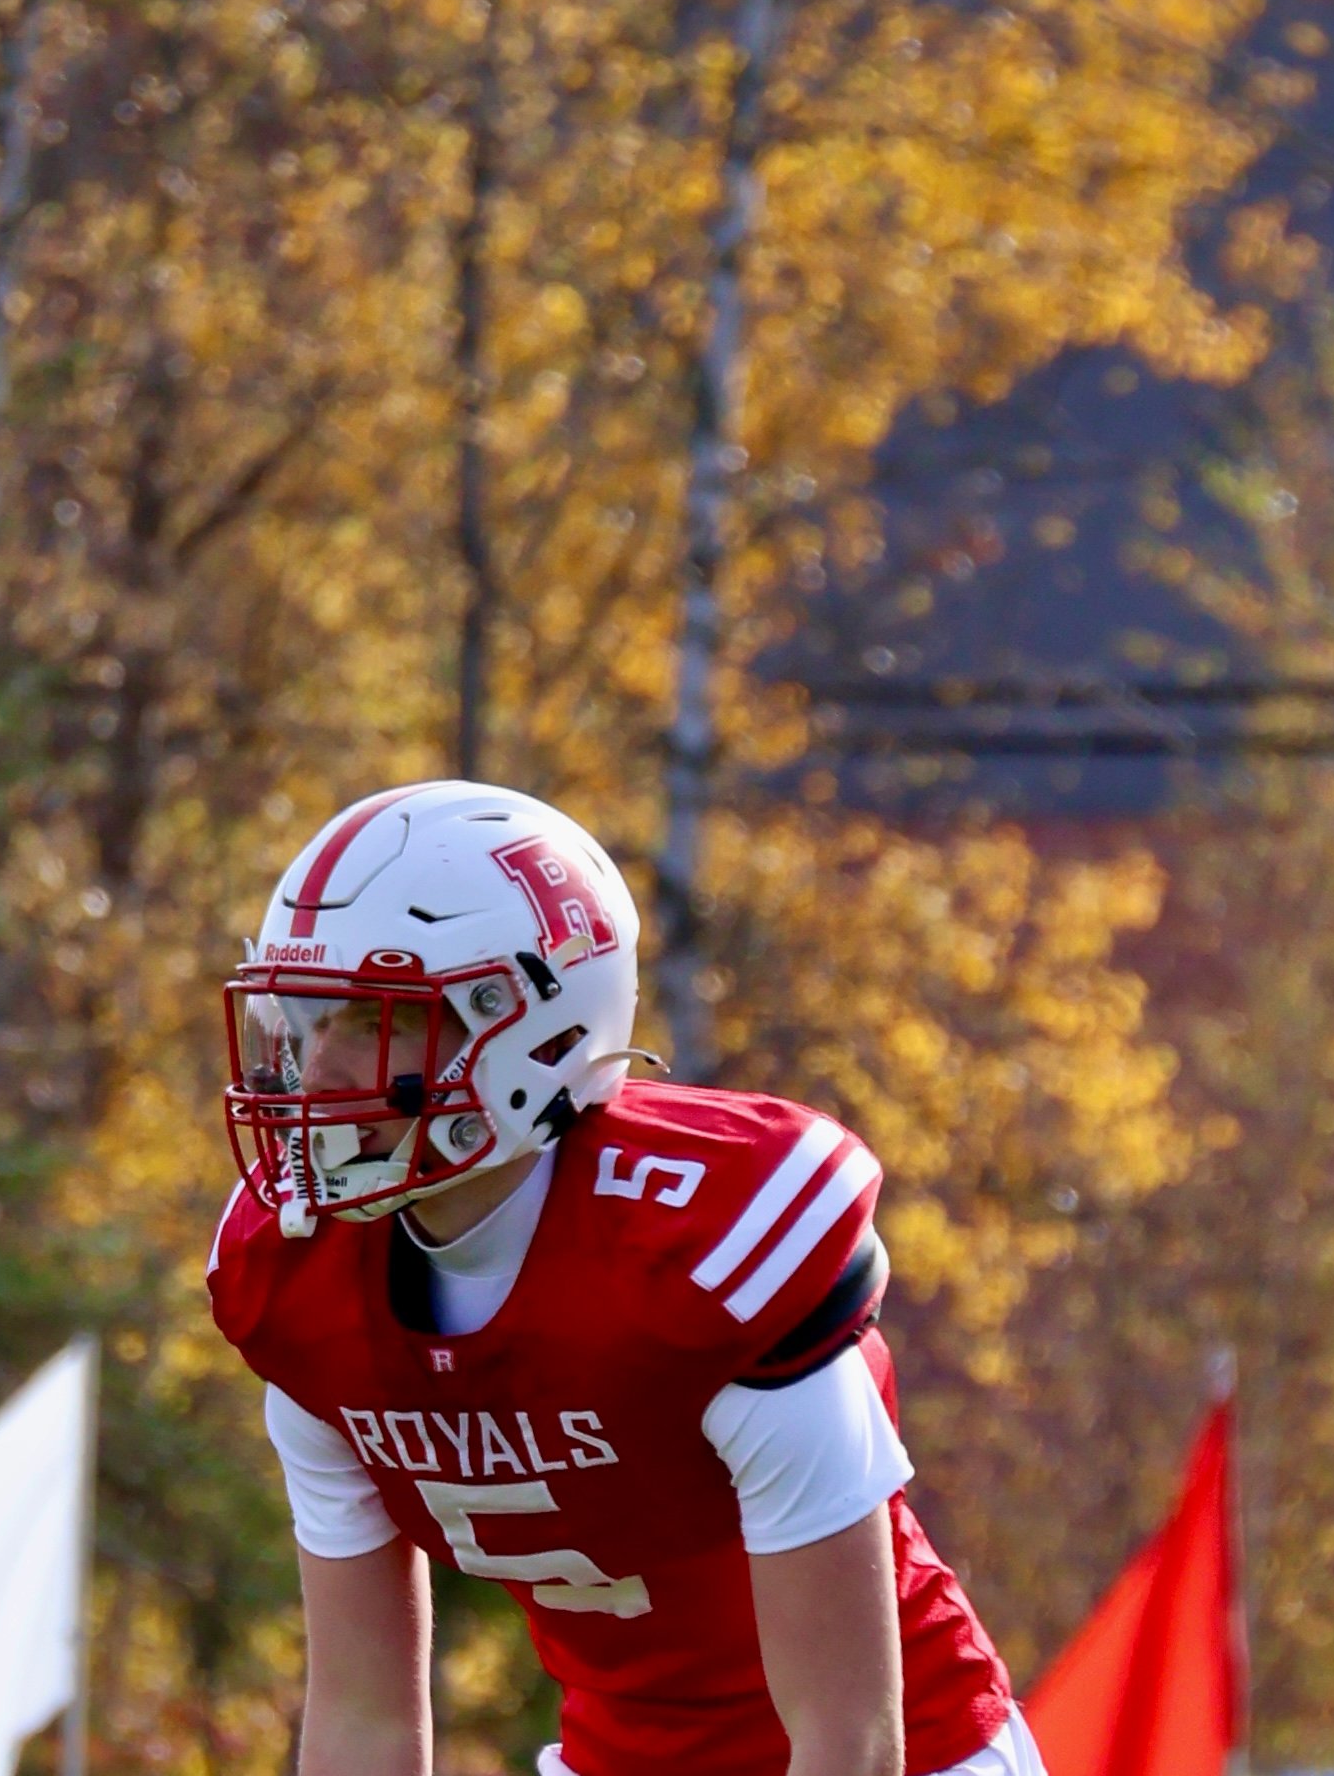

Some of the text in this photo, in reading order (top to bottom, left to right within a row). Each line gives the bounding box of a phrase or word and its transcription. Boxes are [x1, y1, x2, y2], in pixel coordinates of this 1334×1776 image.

[264, 943, 327, 963] Riddell
[593, 1146, 707, 1208] 5
[429, 1348, 456, 1373] R
[339, 1406, 619, 1477] ROYALS
[414, 1478, 653, 1619] 5
